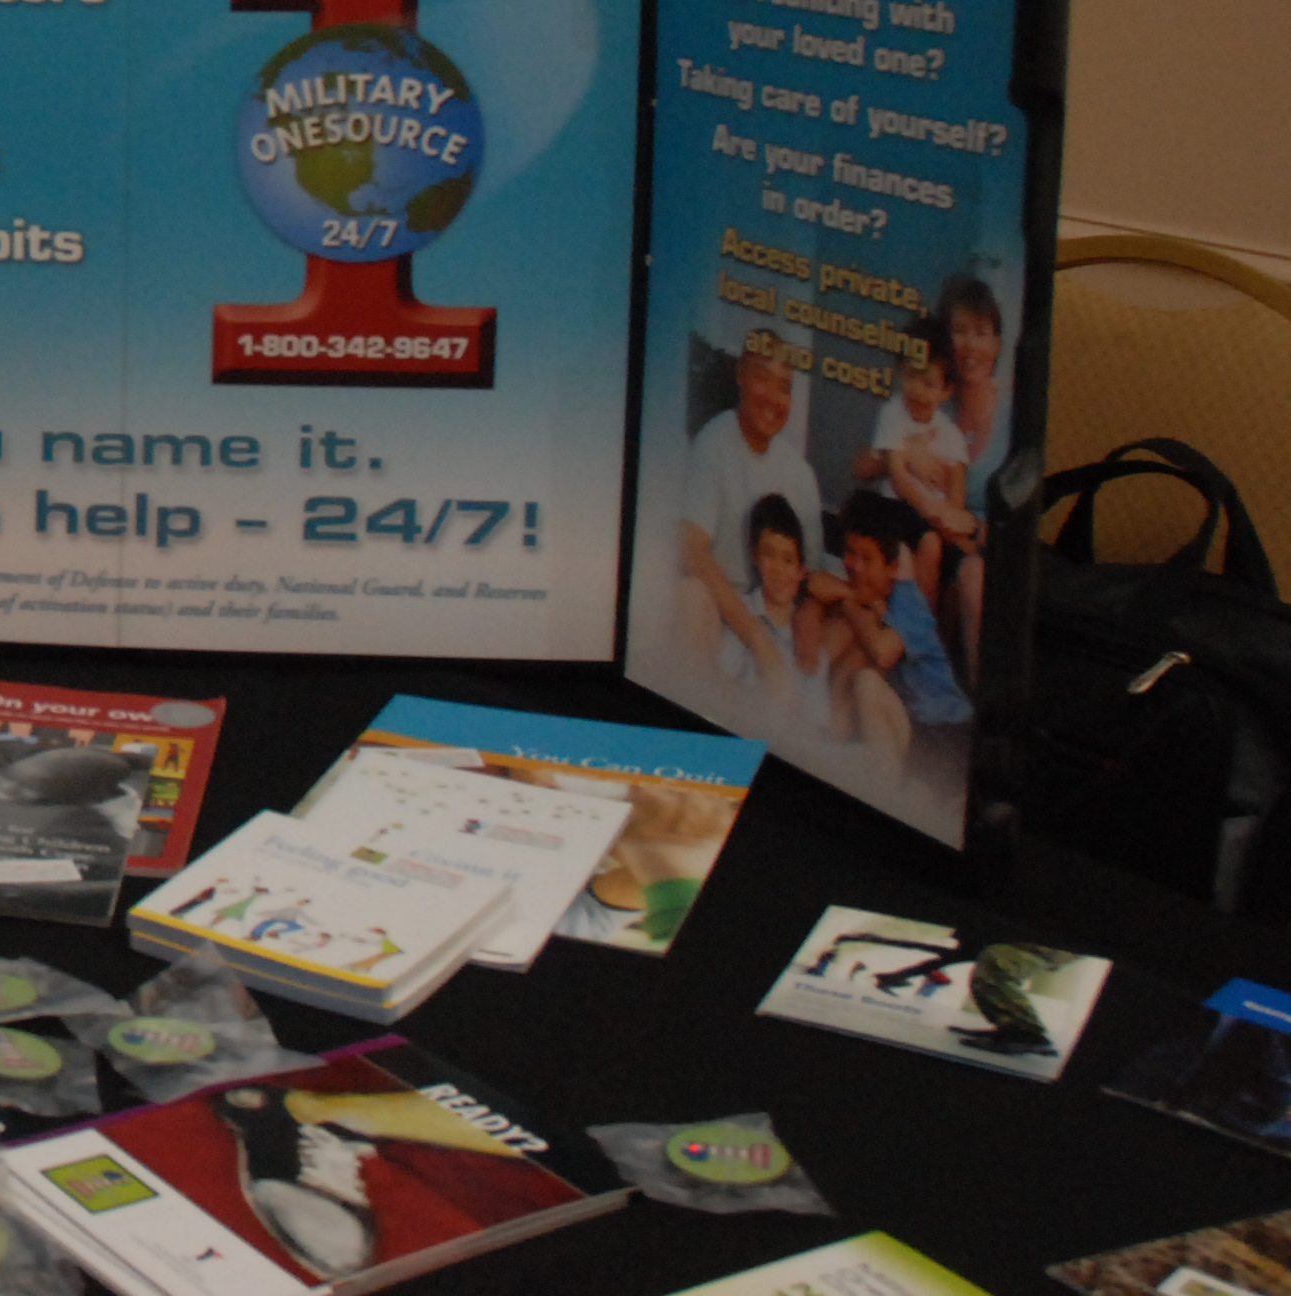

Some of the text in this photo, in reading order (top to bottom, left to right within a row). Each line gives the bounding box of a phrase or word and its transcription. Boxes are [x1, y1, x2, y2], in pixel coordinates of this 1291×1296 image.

[727, 19, 946, 80] your loved one?
[265, 72, 456, 119] MILITARY
[677, 57, 1008, 157] Taking care of yourself?
[250, 111, 470, 166] ONESOURCE
[712, 123, 955, 209] Are your finances
[322, 218, 399, 249] 24/7
[761, 180, 888, 239] in order?
[721, 226, 928, 319] Access private,
[237, 333, 469, 360] 1-800-342-9647
[719, 271, 931, 370] local counseling
[745, 329, 893, 398] at no cost!
[42, 430, 260, 468] name
[300, 424, 382, 470] it.
[35, 490, 201, 548] help
[303, 495, 539, 547] 24/7!
[47, 571, 69, 589] of
[71, 571, 139, 590] Defense
[276, 576, 356, 595] National
[432, 581, 470, 598] and
[177, 602, 214, 618] and
[218, 602, 261, 619] their
[31, 699, 101, 719] your
[108, 707, 153, 722] ow
[581, 757, 643, 775] Can
